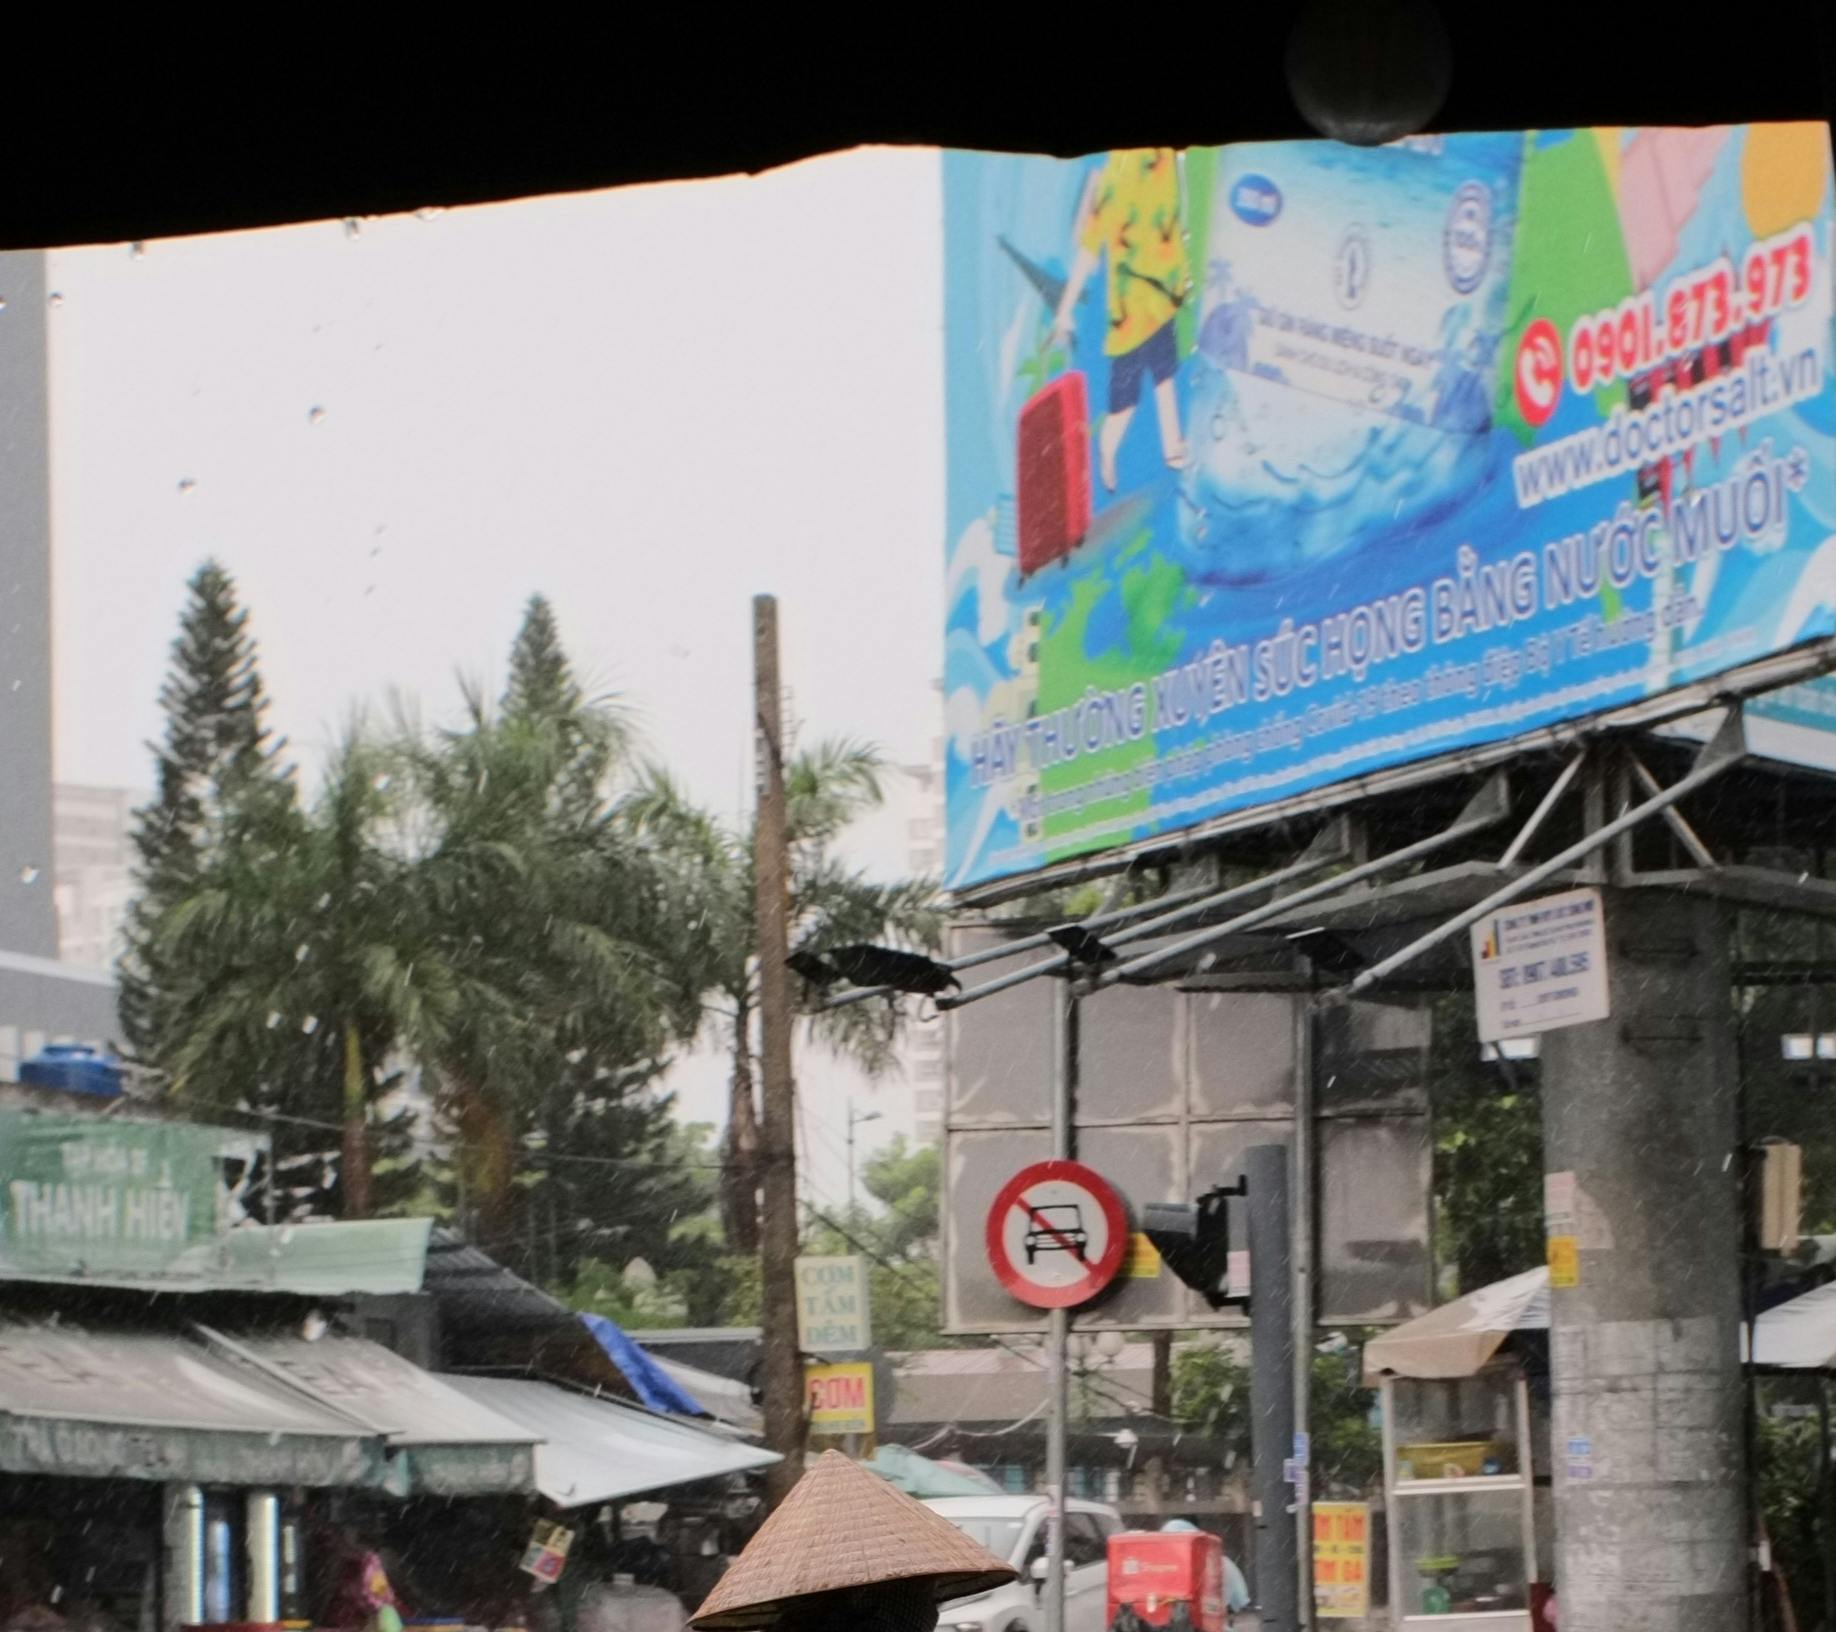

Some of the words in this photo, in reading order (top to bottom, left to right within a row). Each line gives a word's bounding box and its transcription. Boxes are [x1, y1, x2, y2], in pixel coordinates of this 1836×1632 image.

[1573, 232, 1811, 390] 0901.873.973
[1517, 347, 1817, 500] www.doctorsalt.vn
[1320, 587, 1426, 683] HỌNG
[1433, 545, 1538, 645] BẰNG
[1543, 501, 1662, 609] NƯỚC
[9, 1178, 118, 1237] THANH
